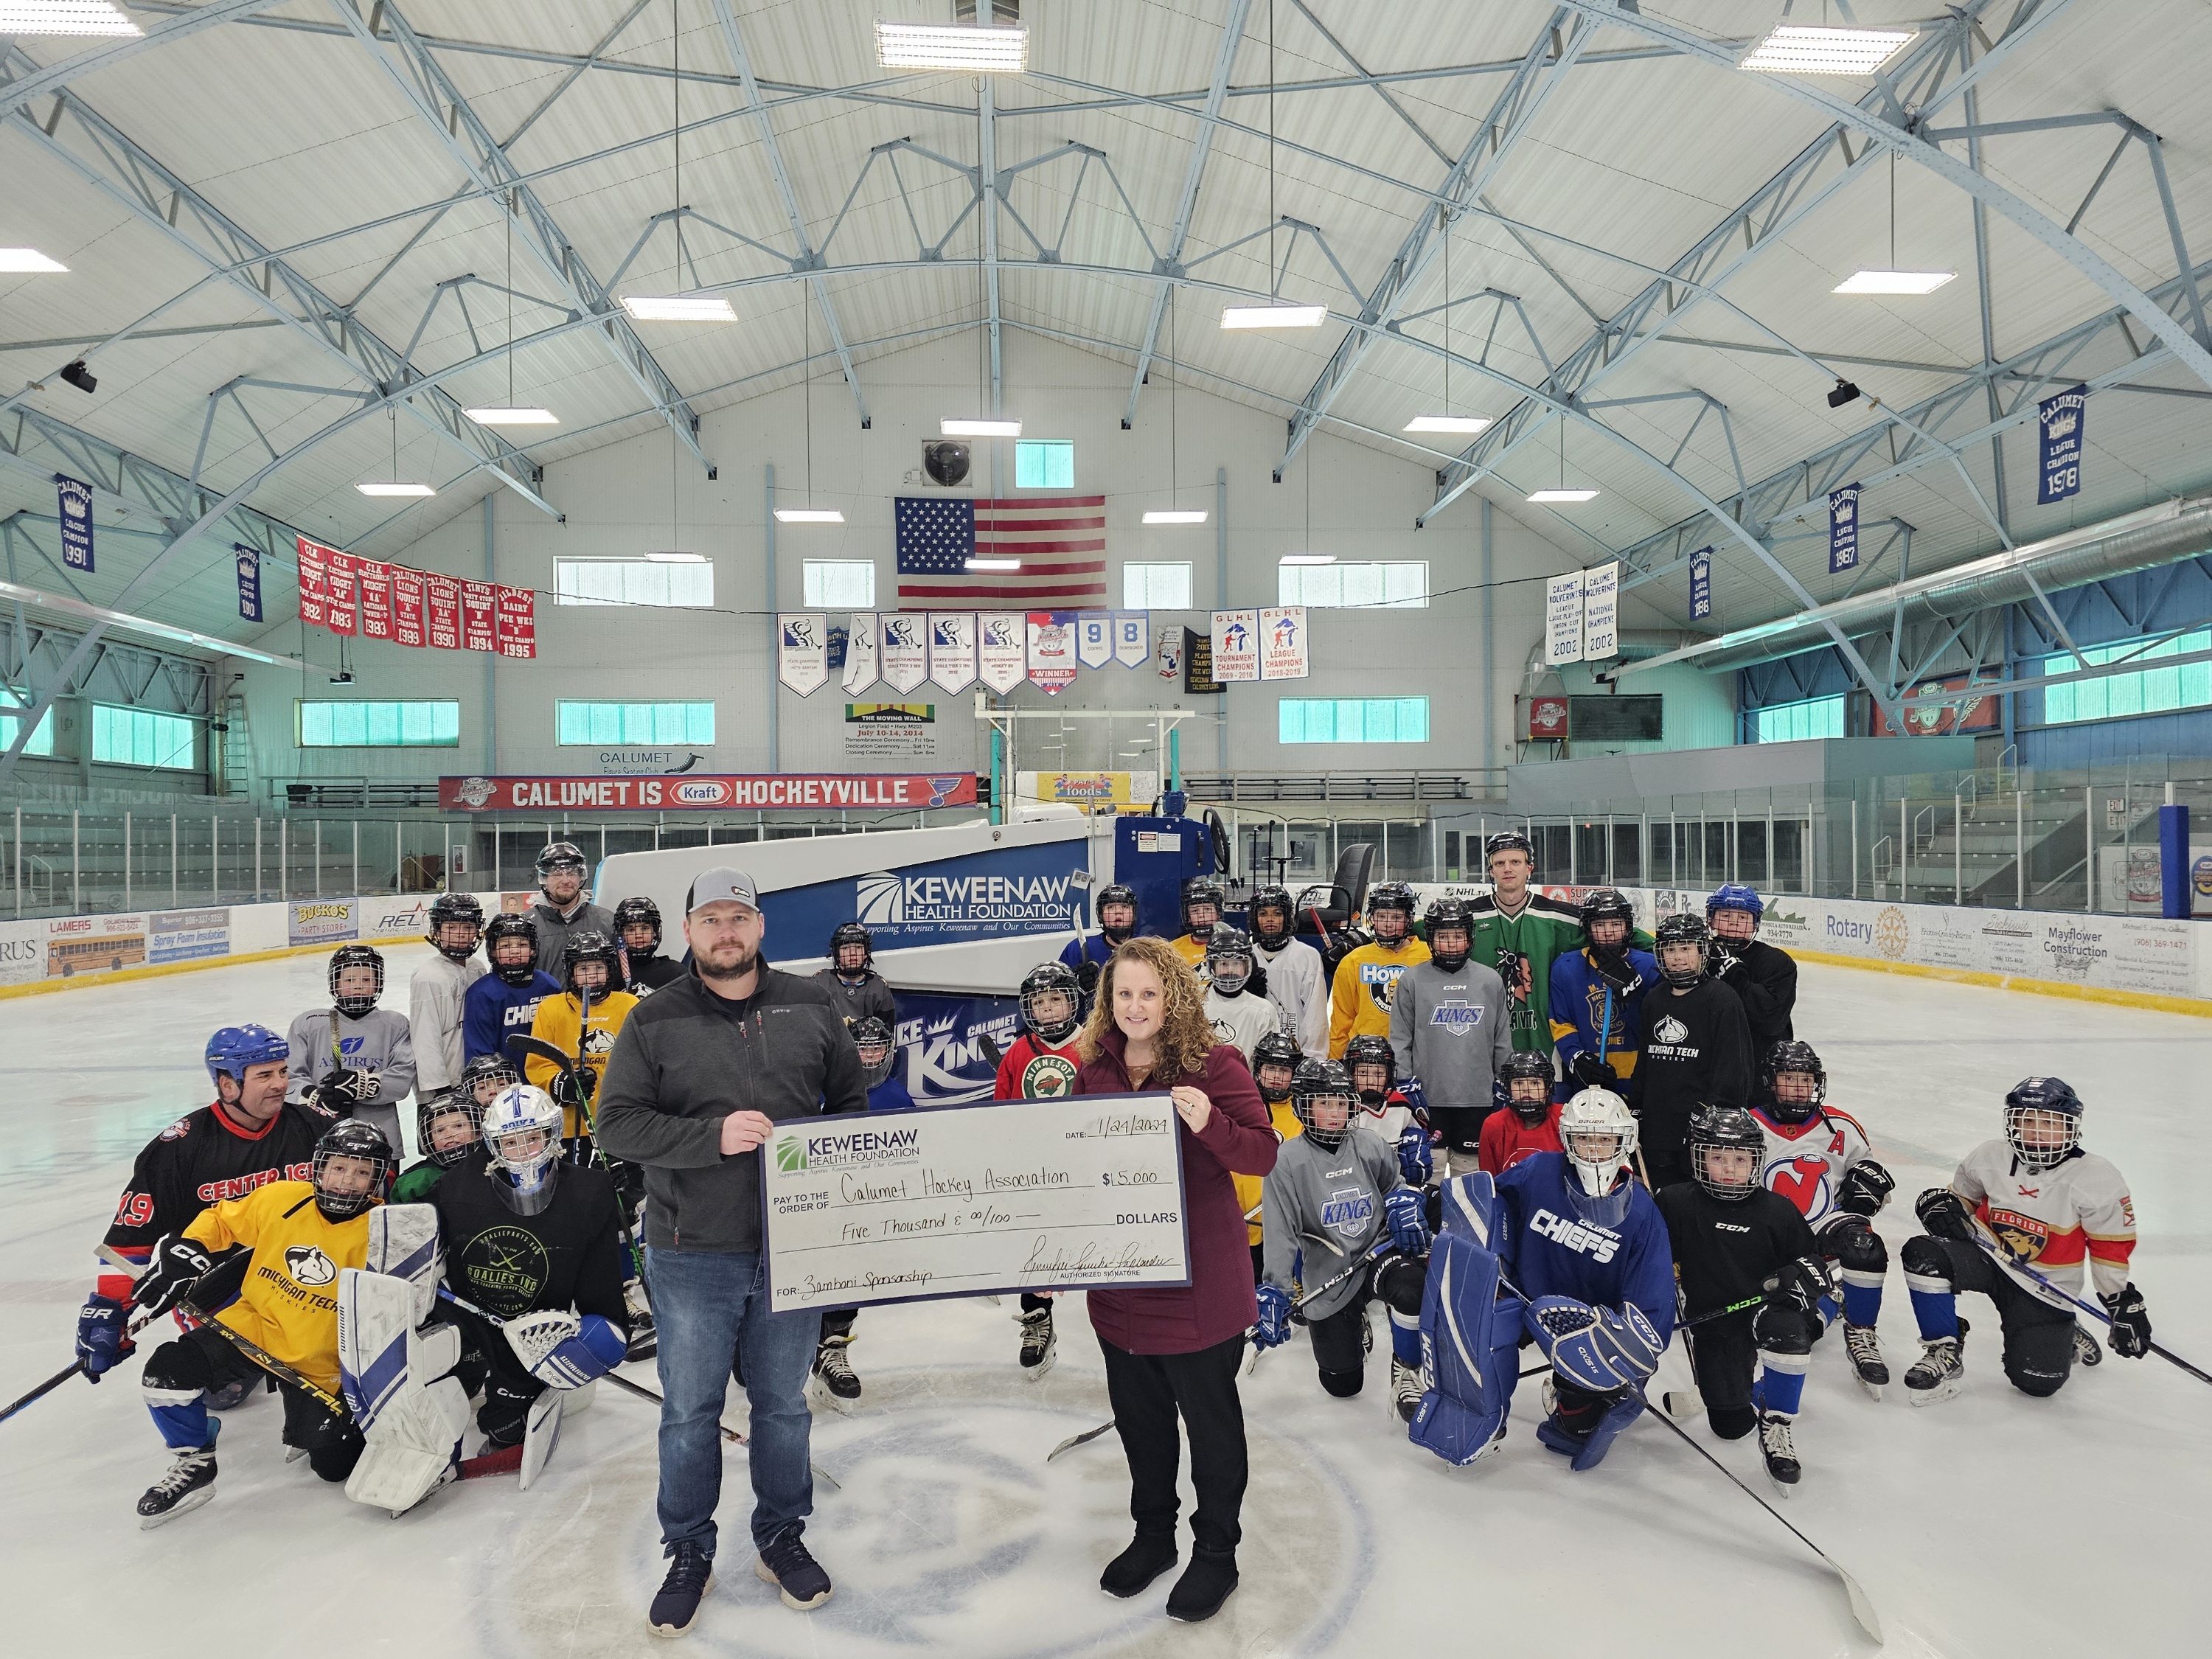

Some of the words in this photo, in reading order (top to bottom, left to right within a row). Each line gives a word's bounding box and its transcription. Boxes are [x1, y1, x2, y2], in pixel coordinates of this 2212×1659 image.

[2039, 394, 2084, 424] CALUMET
[58, 481, 91, 504] CALUMET
[1829, 490, 1858, 511] CALUMET
[65, 543, 87, 566] 1991
[305, 544, 318, 558] CLK
[1836, 546, 1855, 568] 1987
[333, 555, 348, 568] CLK
[366, 563, 383, 574] CLK
[1590, 571, 1614, 587] CALUMET
[397, 580, 419, 594] LIONS
[431, 586, 454, 599] LIONS
[465, 583, 491, 596] TINY'S
[1553, 580, 1578, 594] CALUMET
[1585, 581, 1616, 597] WOLVERINES
[396, 591, 420, 605] SQUIRT
[431, 596, 456, 610] SQUIRT
[498, 588, 534, 605] JILBERT
[465, 599, 491, 611] SQUIRT
[503, 601, 528, 613] DAIRY
[1556, 604, 1574, 613] LEAGUE
[1588, 603, 1613, 616] NATIONAL
[400, 611, 416, 620] STATE
[435, 616, 451, 625] STATE
[498, 613, 513, 624] PEE
[516, 616, 533, 626] WEE
[1587, 615, 1614, 628] CHAMPIONS
[365, 619, 386, 636] 1983
[471, 620, 487, 628] STATE
[398, 627, 420, 644] 1989
[433, 631, 455, 647] 1990
[1088, 623, 1102, 643] 9
[1124, 622, 1138, 642] 8
[469, 636, 493, 651] 1994
[1554, 639, 1576, 656] 2002
[1590, 633, 1613, 651] 2002
[504, 643, 530, 658] 1995
[1270, 649, 1295, 658] LEAGUE
[1265, 658, 1303, 668] CHAMPIONS
[1034, 669, 1070, 678] WINNER
[1267, 669, 1301, 677] 2018-2019
[600, 752, 672, 763] CALUMET
[603, 766, 620, 774] Figure
[622, 766, 644, 774] Skating
[512, 782, 631, 807] CALUMET
[639, 781, 662, 805] IS
[684, 785, 717, 801] Kraft
[736, 780, 909, 806] HOCKEYVILLE
[1067, 785, 1102, 796] foods
[2110, 800, 2121, 810] EXIT
[905, 876, 1070, 905] KEWEENAW
[1455, 888, 1486, 897] NHL.TV
[298, 903, 349, 924] BUCKO'S
[905, 905, 961, 919] HEALTH
[968, 903, 1070, 919] FOUNDATION
[50, 919, 91, 933] LAMERS
[378, 914, 421, 928] REL
[904, 923, 933, 934] Aspirus
[939, 923, 978, 932] Keweenaw
[983, 922, 998, 931] and
[1003, 922, 1019, 931] Our
[1024, 922, 1071, 931] Communities
[301, 925, 320, 935] PARTY
[321, 923, 344, 933] STORE
[1827, 915, 1872, 945] Rotary
[2048, 927, 2102, 943] Mayflower
[154, 935, 175, 947] Spray
[177, 932, 195, 944] Foam
[196, 929, 226, 942] Insulation
[2135, 938, 2152, 947] (906)
[2154, 940, 2187, 950] 369-1471
[2043, 942, 2107, 958] Construction
[1434, 1007, 1482, 1023] KINGS
[967, 1013, 1018, 1037] CALUMET
[1676, 1047, 1699, 1058] TECH
[1026, 1058, 1075, 1082] MINNESOTA
[1099, 1115, 1166, 1138] 1/24/2024
[808, 1129, 918, 1156] KEWEENAW
[1826, 1129, 1846, 1156] A
[809, 1153, 846, 1166] HEALTH
[850, 1147, 919, 1162] FOUNDATION
[778, 1169, 806, 1180] Supporting
[809, 1168, 829, 1176] Aspirus
[832, 1165, 858, 1173] Keweenaw
[1325, 1167, 1353, 1179] CCM
[198, 1168, 279, 1202] CENTER
[841, 1172, 908, 1203] Calumet
[922, 1169, 973, 1202] Hockey
[985, 1166, 1069, 1190] Association
[773, 1196, 791, 1206] PAY
[794, 1194, 807, 1203] TO
[810, 1192, 830, 1201] THE
[1335, 1191, 1358, 1201] CALUMET
[114, 1191, 154, 1228] 19
[779, 1203, 814, 1214] ORDER
[815, 1201, 830, 1210] OF
[1324, 1196, 1373, 1223] KINGS
[1116, 1212, 1178, 1225] DOLLARS
[1994, 1212, 2044, 1235] FLORIDA
[842, 1222, 870, 1241] Five
[880, 1212, 946, 1236] Thousand
[1578, 1218, 1622, 1241] CALUMET
[1714, 1222, 1751, 1233] CCM
[1529, 1208, 1621, 1264] CHIEFS
[467, 1267, 515, 1284] GOALIES
[520, 1276, 537, 1291] INC
[1060, 1271, 1102, 1279] AUTHORIZED
[1103, 1270, 1141, 1278] SIGNATURE
[257, 1266, 307, 1301] MICHIGAN
[308, 1293, 338, 1313] TECH
[776, 1287, 801, 1297] FOR:
[801, 1274, 858, 1301] Zamboni
[862, 1269, 933, 1292] Sponsorship
[1632, 1315, 1658, 1345] CCM
[560, 1354, 591, 1382] WARRIOR
[1422, 1332, 1436, 1389] CCM
